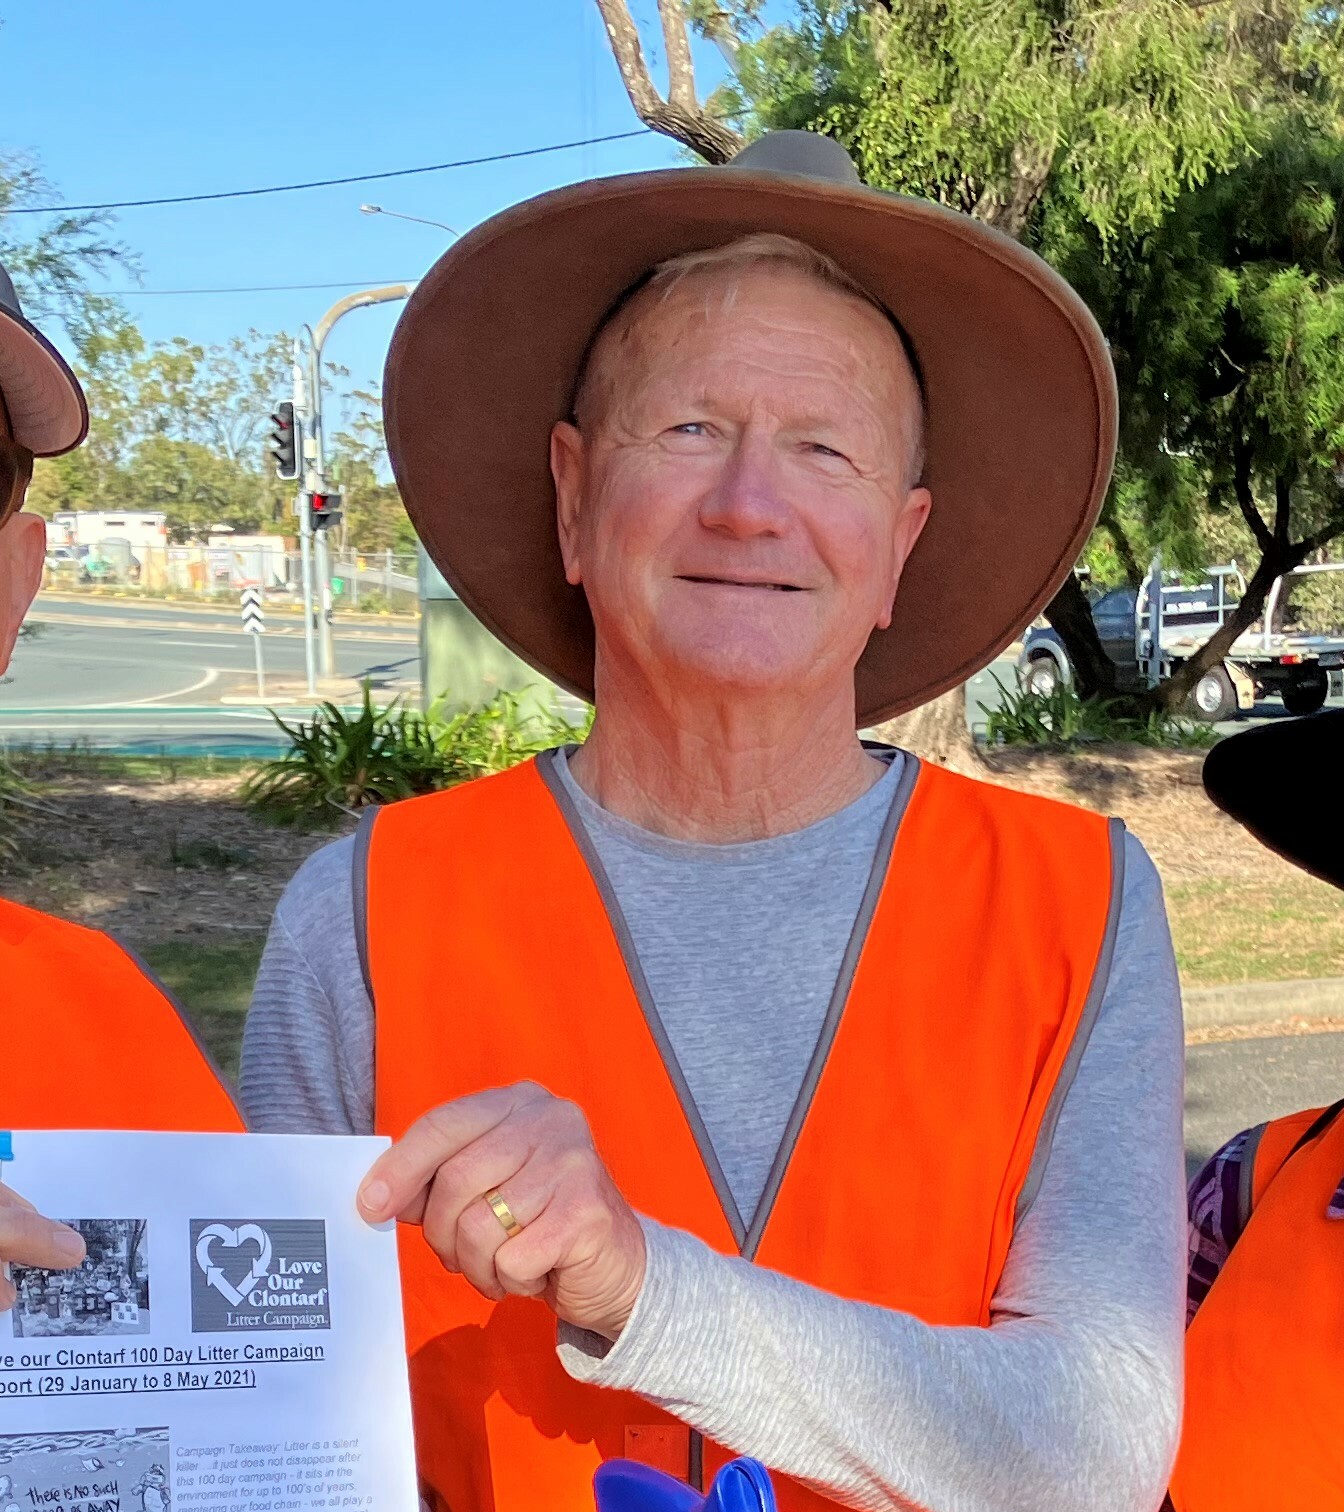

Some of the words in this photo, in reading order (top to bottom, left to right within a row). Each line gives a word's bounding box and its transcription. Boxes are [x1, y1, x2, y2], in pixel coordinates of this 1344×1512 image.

[278, 1257, 323, 1275] Love
[267, 1273, 304, 1291] Our
[248, 1288, 328, 1307] Clontarf
[226, 1311, 261, 1327] Litter
[263, 1310, 325, 1329] Campaign
[20, 1354, 51, 1368] our
[56, 1347, 126, 1366] Clontarf
[130, 1347, 157, 1363] 100
[163, 1346, 193, 1364] Day
[198, 1345, 239, 1361] Litter
[243, 1343, 324, 1361] Campaign
[38, 1376, 64, 1396] (29
[70, 1375, 138, 1393] January
[143, 1374, 157, 1389] to
[163, 1372, 172, 1388] 8
[177, 1371, 209, 1389] May
[214, 1368, 256, 1388] 2021)
[240, 1457, 265, 1468] does
[267, 1456, 284, 1467] not
